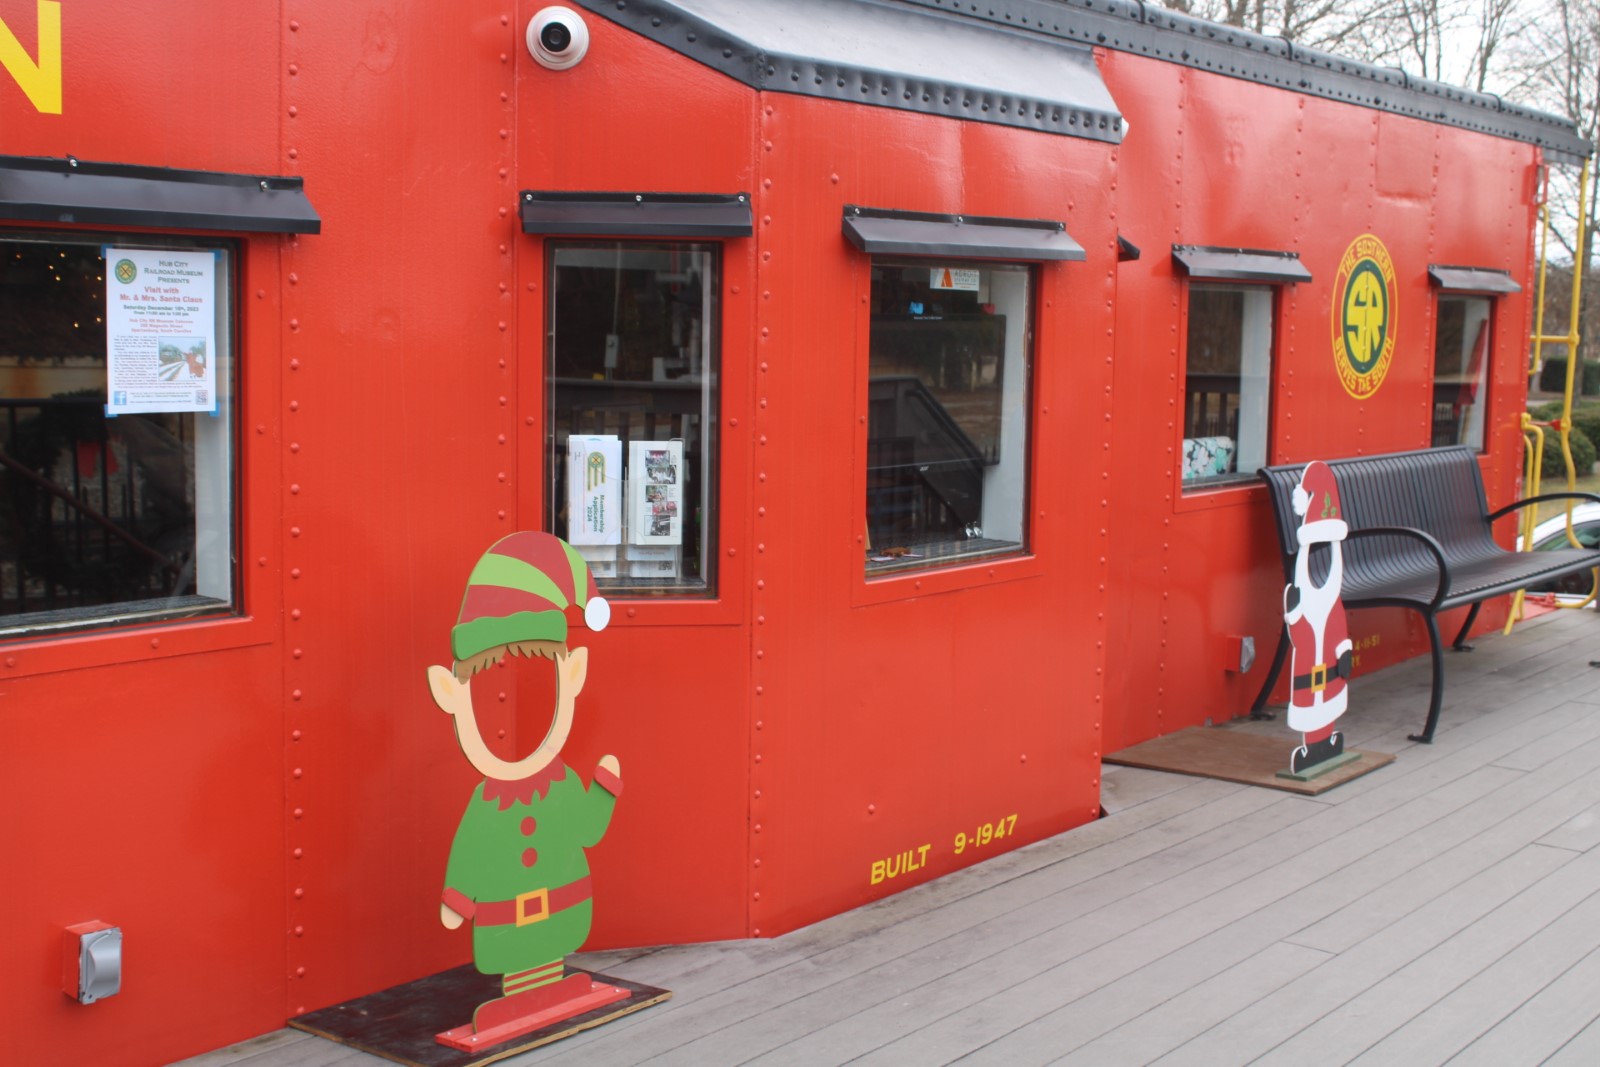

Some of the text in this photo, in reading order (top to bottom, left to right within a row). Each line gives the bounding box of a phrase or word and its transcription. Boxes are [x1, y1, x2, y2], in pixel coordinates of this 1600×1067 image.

[1340, 248, 1356, 278] THE
[144, 286, 162, 294] Visit
[160, 295, 181, 303] Santa
[1335, 336, 1393, 393] SERVES THE SOUTH
[871, 813, 1018, 885] BUILT 9-1947
